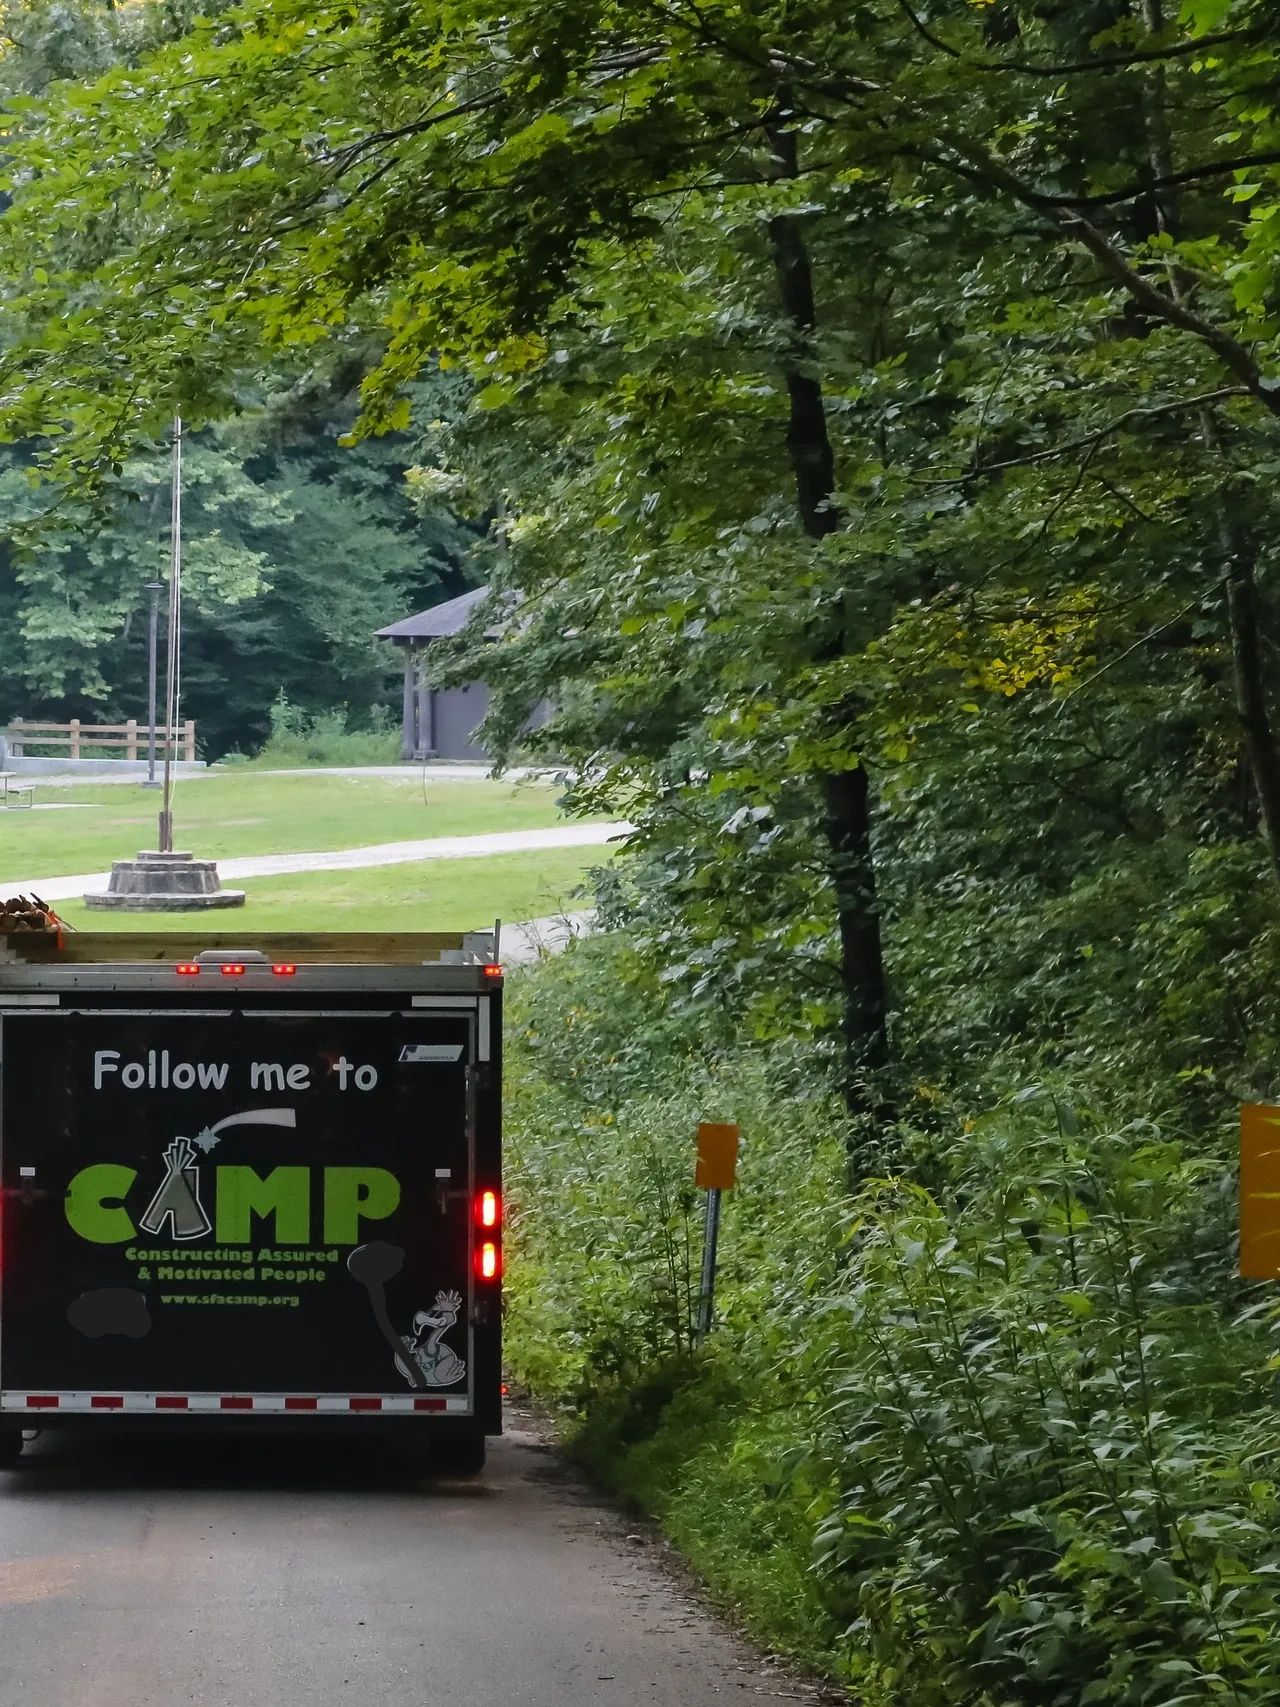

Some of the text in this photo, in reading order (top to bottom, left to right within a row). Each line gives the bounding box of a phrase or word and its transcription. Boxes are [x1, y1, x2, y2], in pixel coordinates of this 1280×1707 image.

[94, 1050, 378, 1091] Follow me to
[64, 1137, 401, 1244] CAMP
[125, 1248, 339, 1263] Constructing Assured
[138, 1267, 326, 1283] & Motivated People
[161, 1294, 300, 1307] www.sfacamp.org
